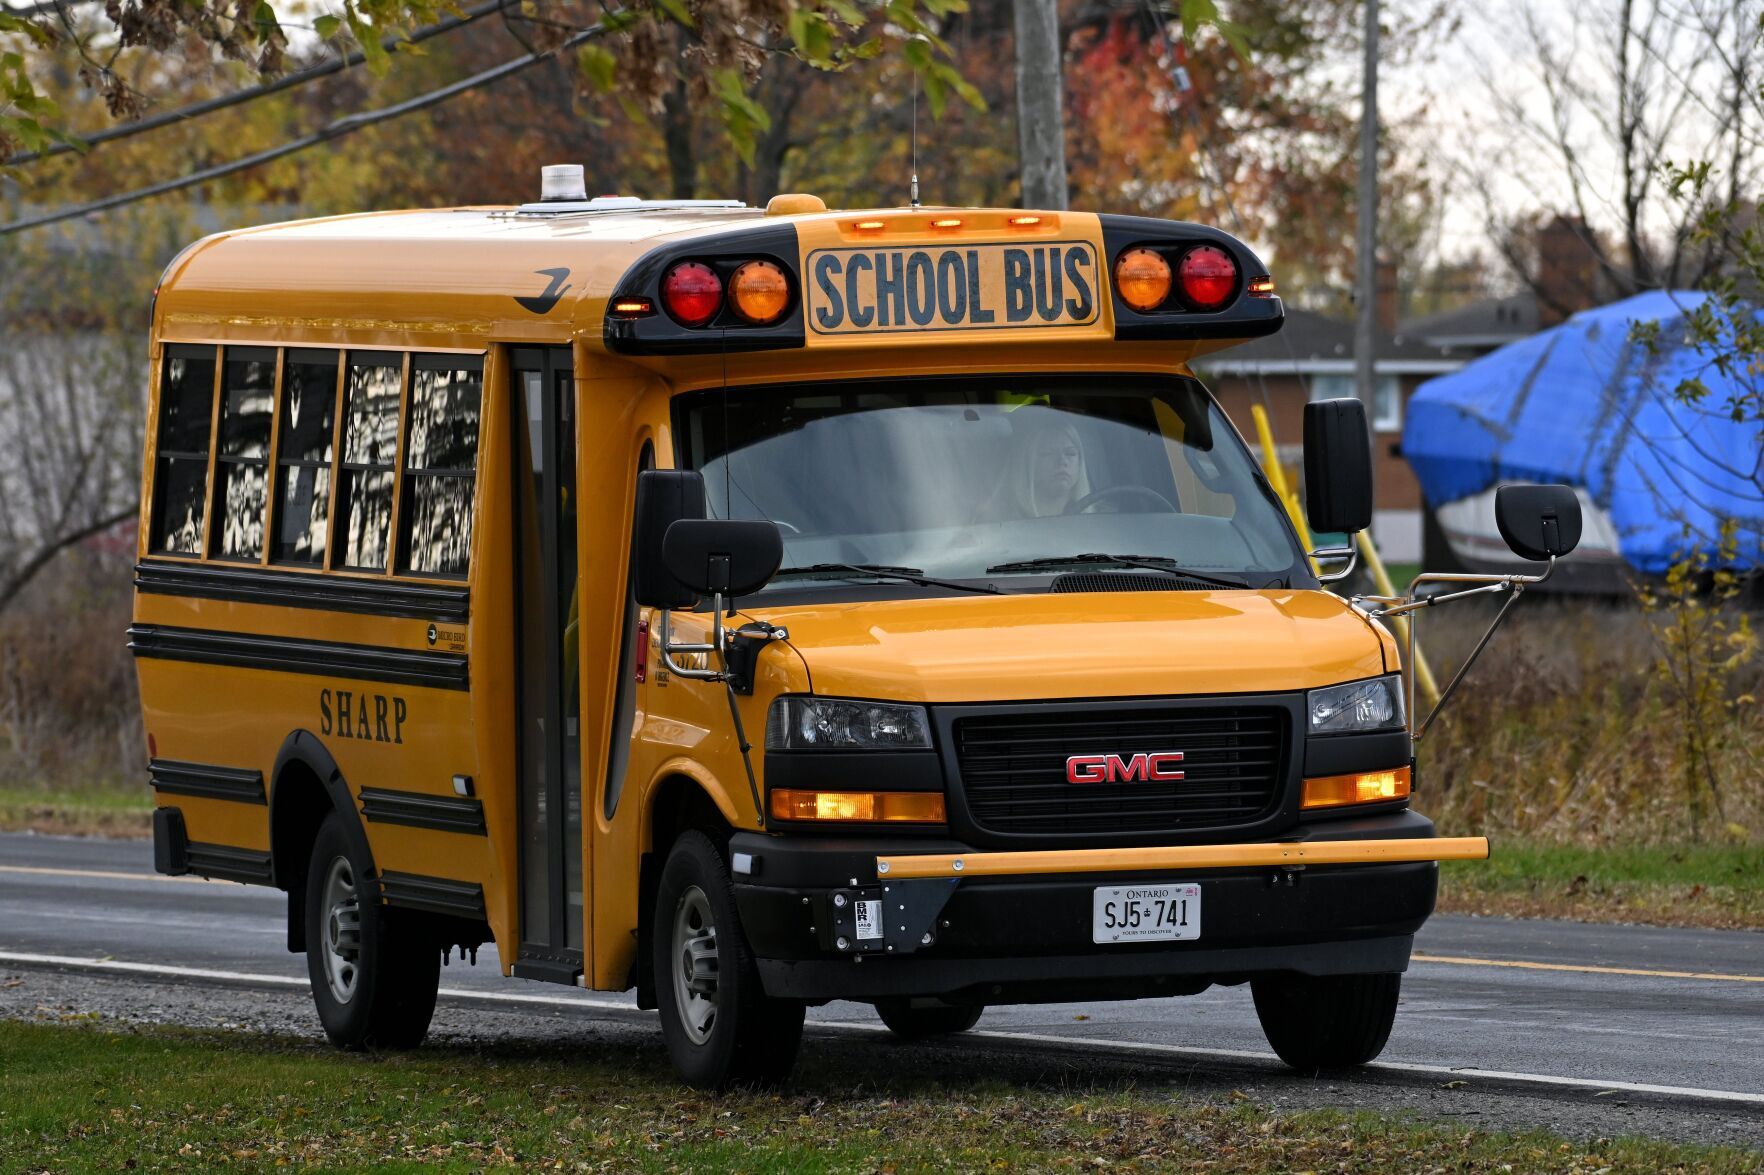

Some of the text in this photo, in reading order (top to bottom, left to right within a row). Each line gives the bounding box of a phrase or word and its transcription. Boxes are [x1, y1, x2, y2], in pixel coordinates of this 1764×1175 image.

[814, 246, 1093, 329] SCHOOL BUS
[320, 688, 407, 744] SHARP
[1066, 751, 1185, 784] GMC
[1105, 899, 1188, 928] SJ5 741
